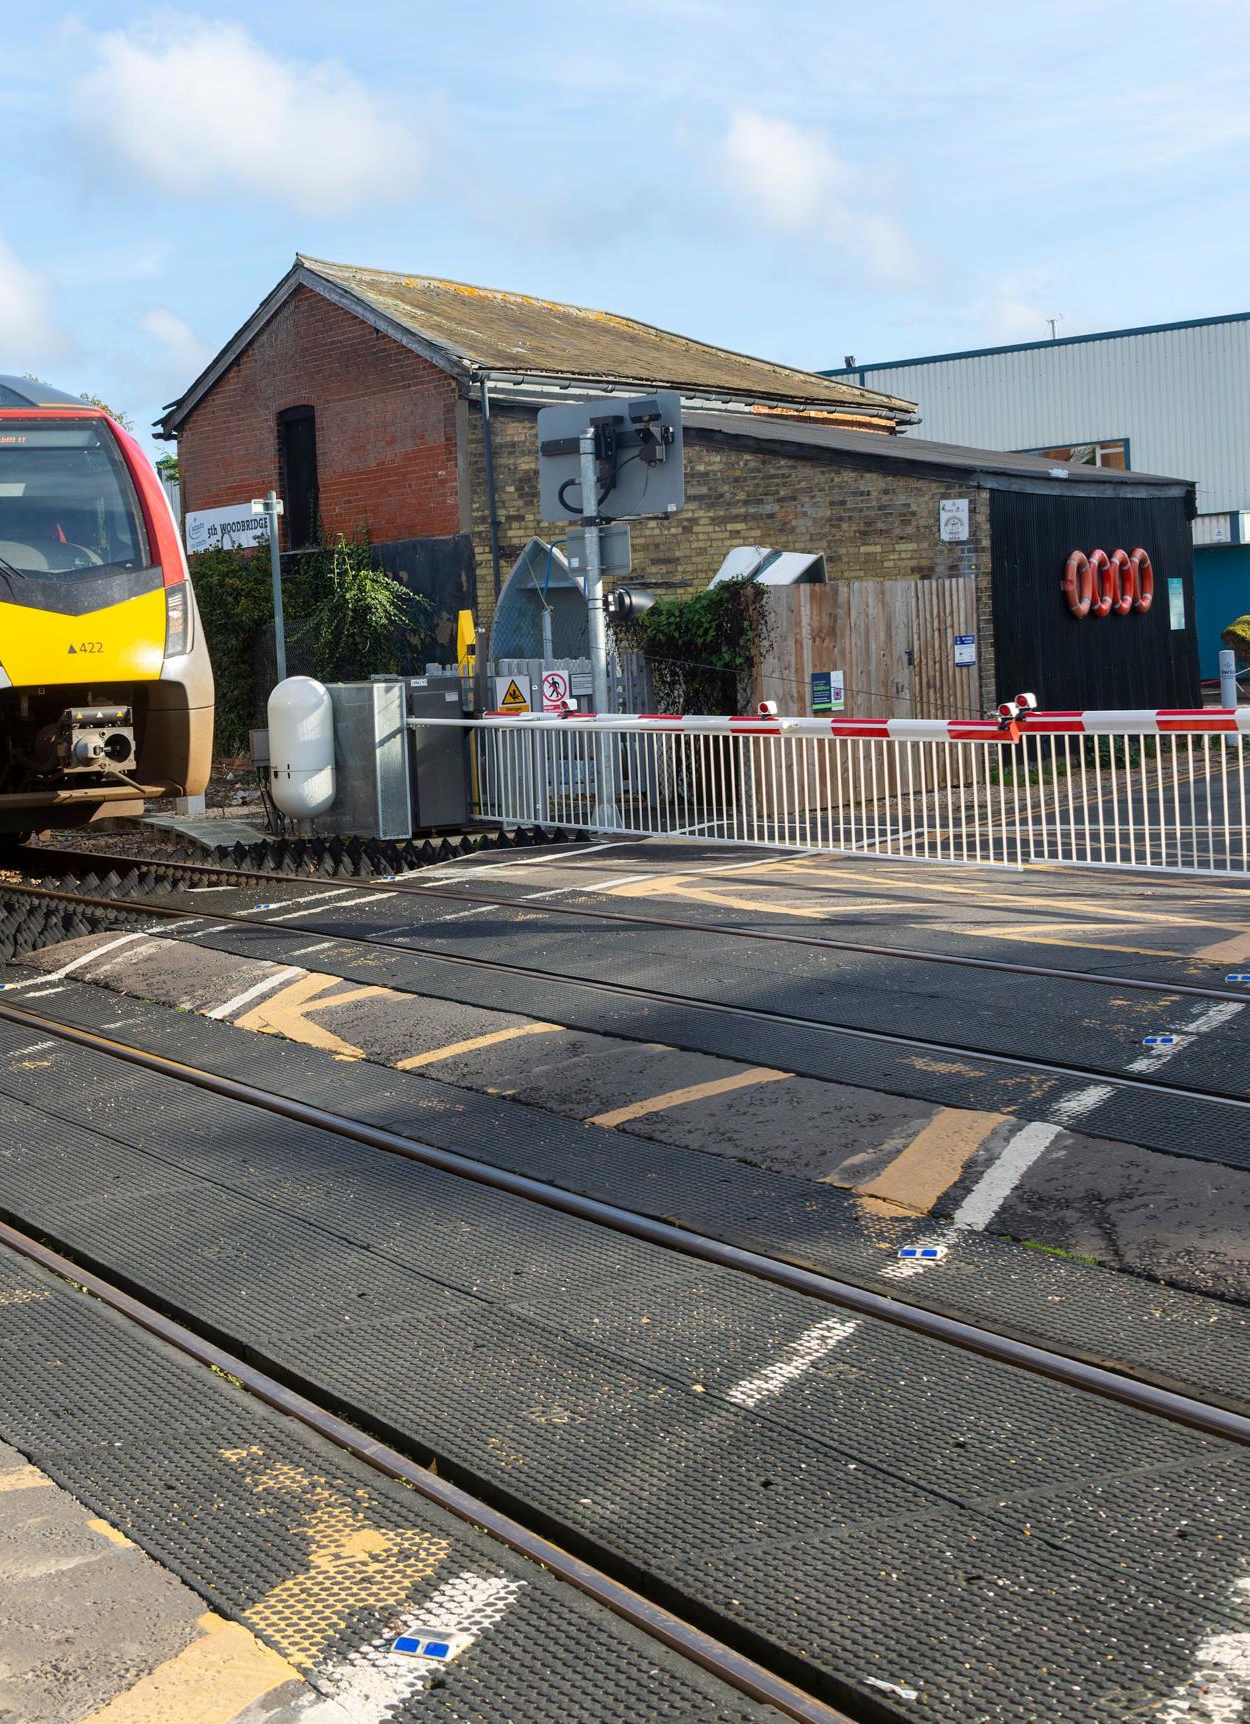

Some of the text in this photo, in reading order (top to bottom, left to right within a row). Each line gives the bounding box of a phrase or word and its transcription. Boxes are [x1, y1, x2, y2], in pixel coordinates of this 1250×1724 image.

[207, 517, 268, 539] 5th WOODBRIDGE
[79, 641, 105, 653] 422
